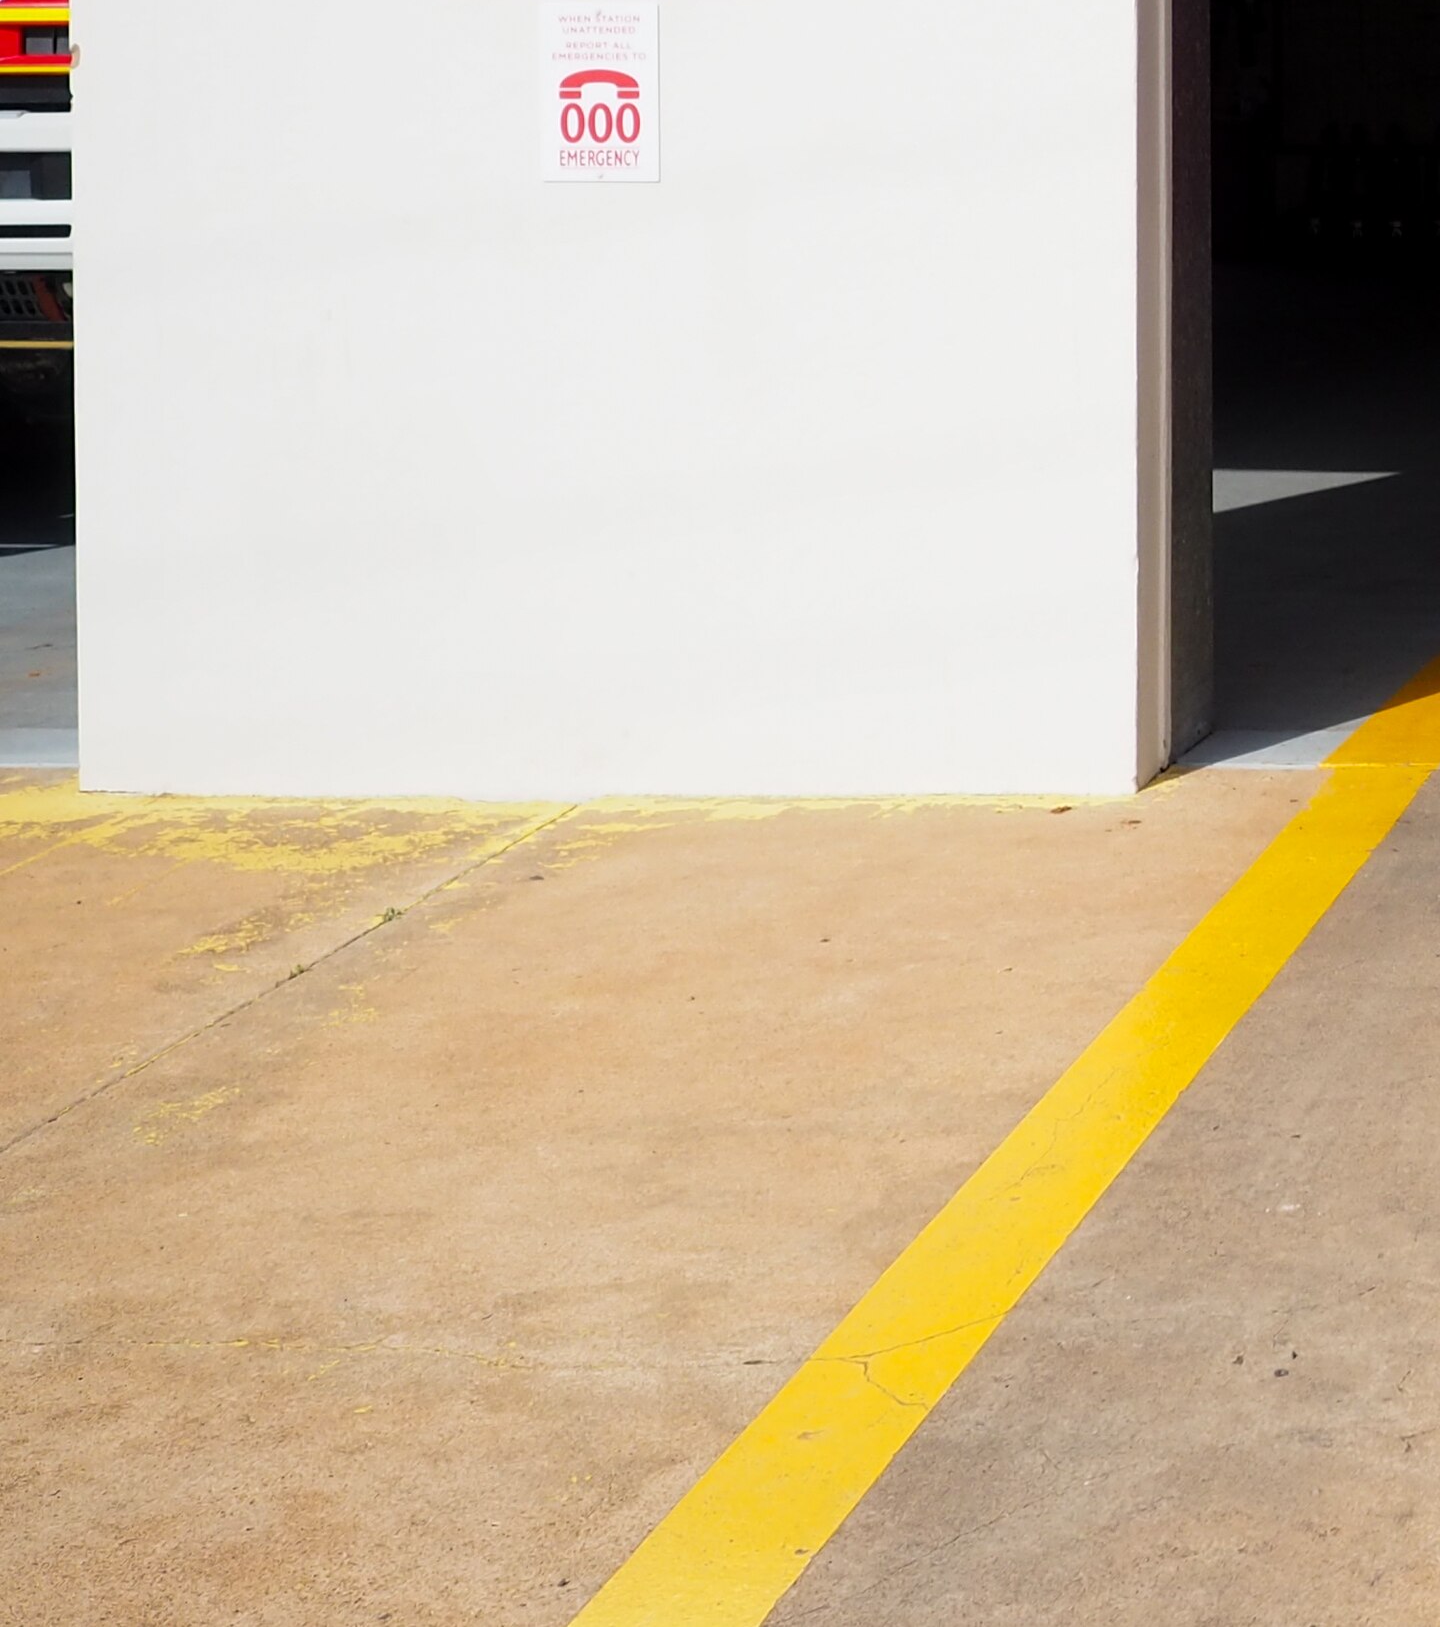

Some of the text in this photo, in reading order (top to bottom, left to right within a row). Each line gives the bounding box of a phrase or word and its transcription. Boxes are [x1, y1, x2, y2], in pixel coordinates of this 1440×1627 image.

[562, 26, 636, 34] UNATTENDED
[565, 41, 608, 49] REPORT
[551, 52, 647, 61] EMERGENCIES TO
[560, 103, 641, 144] 000
[559, 150, 640, 167] EMERGENCY
